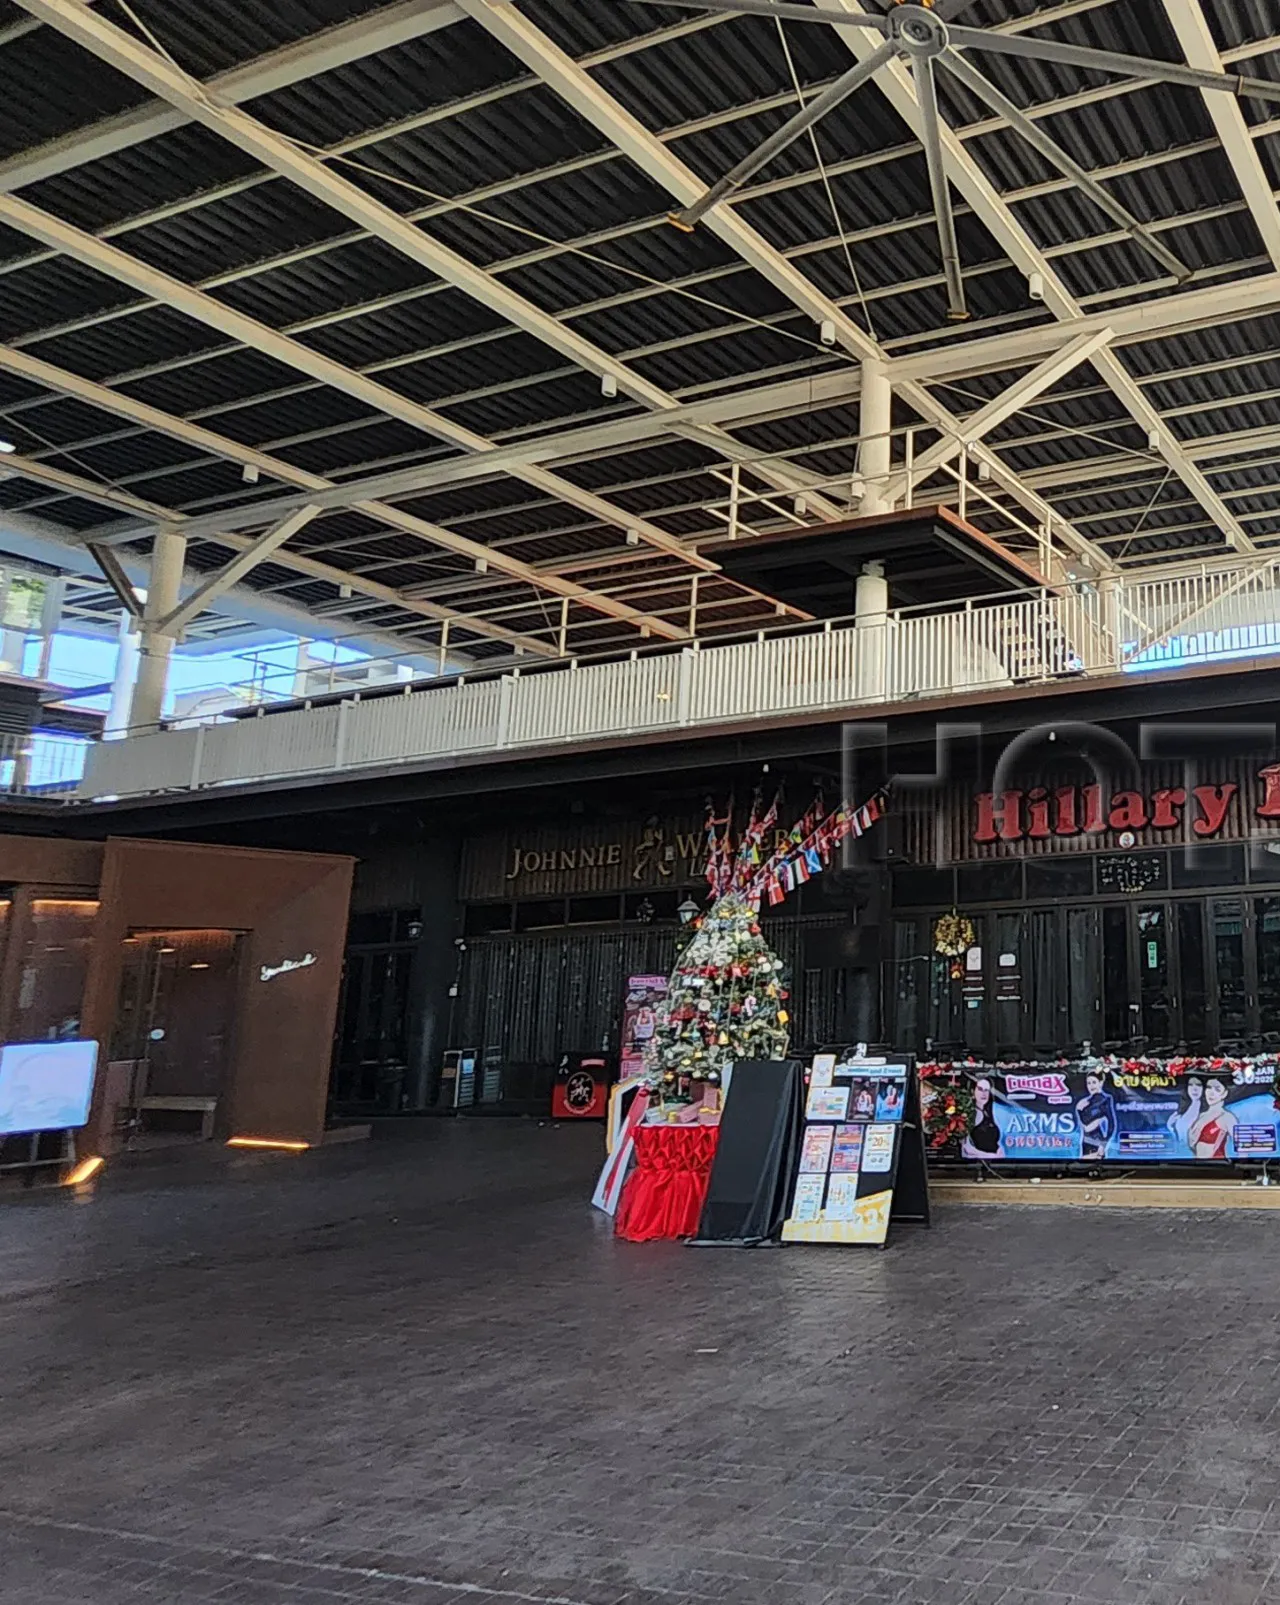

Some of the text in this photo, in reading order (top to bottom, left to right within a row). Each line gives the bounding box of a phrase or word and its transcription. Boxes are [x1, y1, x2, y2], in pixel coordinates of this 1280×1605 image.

[974, 784, 1238, 842] Hillary
[506, 824, 602, 879] JOHNNIE
[1255, 1066, 1275, 1075] JAN
[1007, 1112, 1075, 1133] ARMS
